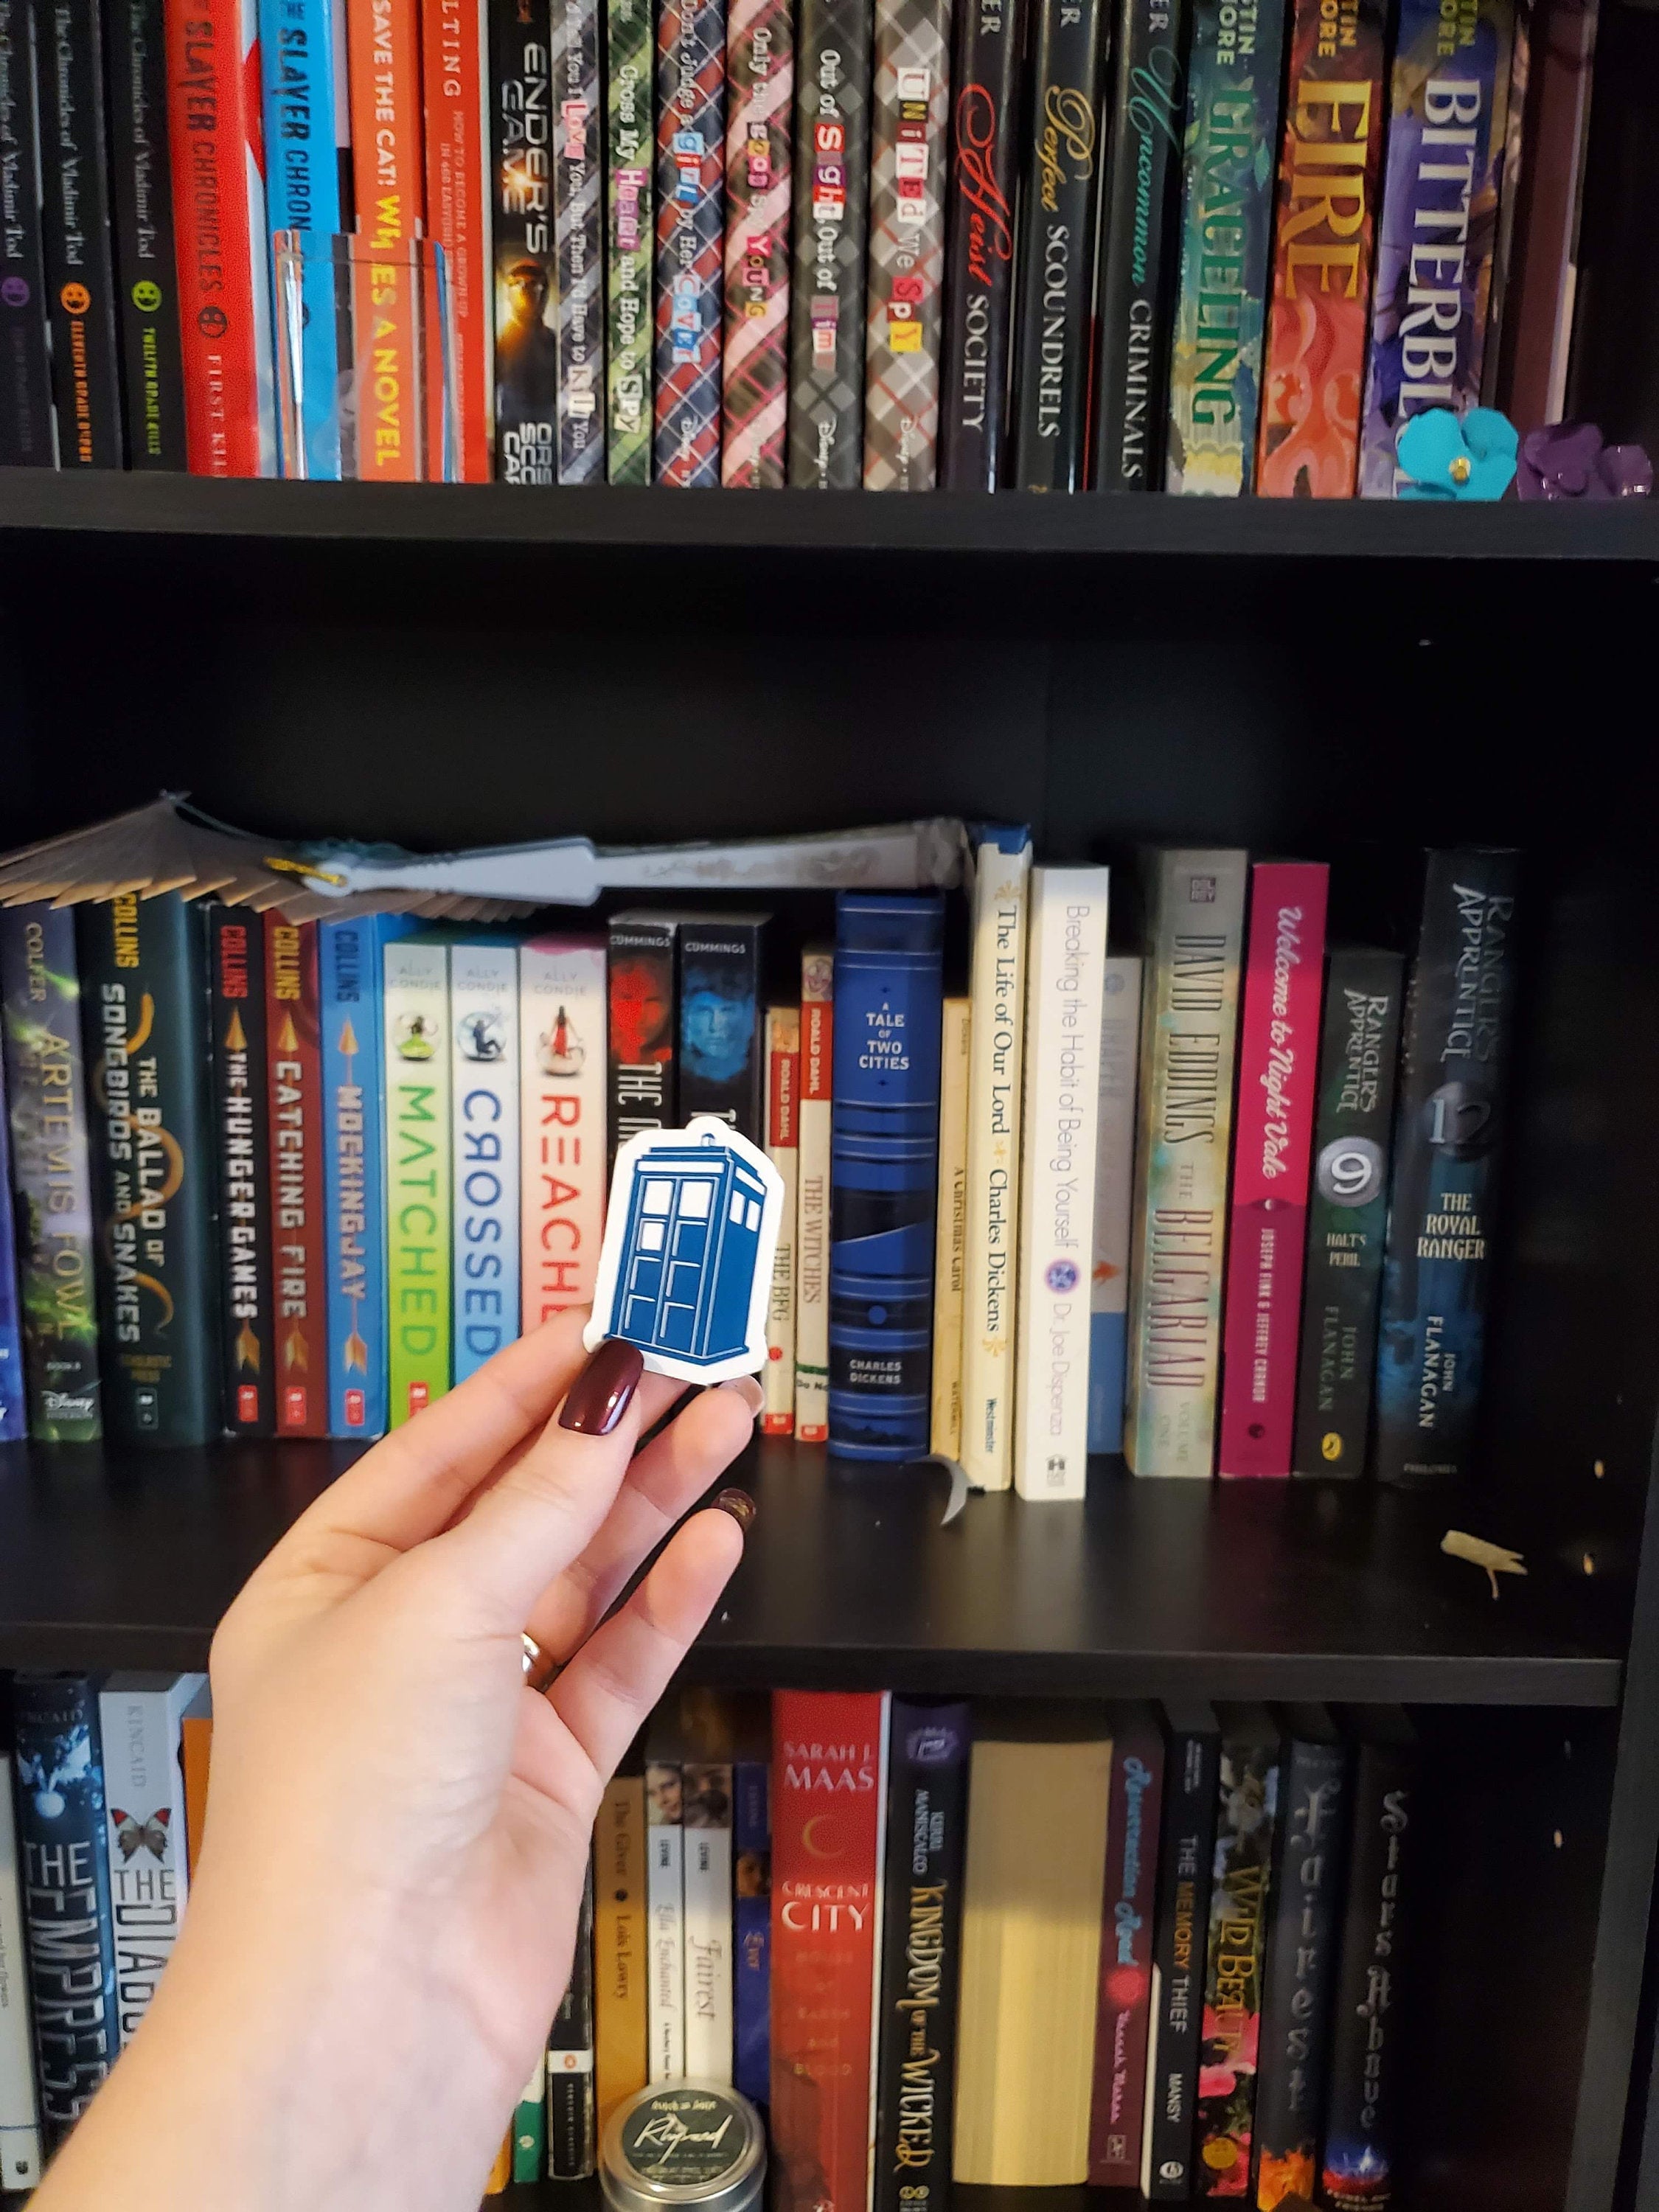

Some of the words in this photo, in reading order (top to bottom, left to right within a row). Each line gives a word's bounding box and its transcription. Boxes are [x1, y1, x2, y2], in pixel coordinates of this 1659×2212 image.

[372, 0, 393, 65] SAVE
[748, 27, 772, 75] Only
[178, 21, 217, 131] SLAYER
[271, 28, 310, 140] SLAYER
[567, 51, 584, 85] You
[678, 52, 698, 110] Judge
[820, 49, 841, 89] Out
[375, 71, 395, 122] THE
[819, 93, 841, 119] of
[375, 128, 397, 186] CAT!
[502, 80, 524, 215] GAME
[524, 43, 548, 254] ENDER'S
[616, 129, 640, 160] My
[1034, 85, 1096, 213] Perfect
[1128, 46, 1183, 287] Uncommon
[62, 156, 83, 228] Vladimir
[136, 150, 156, 221] Vladimir
[954, 83, 1012, 288] Heist
[1281, 79, 1371, 300] FIRE
[5, 224, 27, 258] Tod
[137, 224, 158, 259] Tod
[193, 142, 223, 292] CHRONICLES
[66, 232, 86, 265] Tod
[571, 234, 587, 274] Then
[678, 235, 698, 267] Her
[817, 226, 838, 263] Out
[1192, 86, 1253, 425] GRACELING
[620, 255, 639, 291] and
[816, 266, 837, 291] of
[374, 316, 397, 339] A
[571, 304, 588, 342] Have
[616, 298, 640, 345] Hope
[1037, 225, 1070, 438] SCOUNDRELS
[571, 346, 587, 363] to
[621, 351, 636, 369] to
[963, 294, 990, 434] SOCIETY
[207, 355, 226, 423] FIRST
[374, 348, 400, 467] NOVEL
[1121, 299, 1152, 479] CRIMINALS
[572, 422, 588, 451] You
[113, 898, 139, 969] COLLINS
[610, 934, 671, 947] CUMMINGS
[684, 942, 746, 954] CUMMINGS
[998, 905, 1018, 950] The
[1057, 905, 1090, 991] Breaking
[221, 925, 248, 998] COLLINS
[274, 926, 300, 1001] COLLINS
[335, 931, 360, 1003] COLLINS
[995, 958, 1015, 998] Life
[1171, 934, 1226, 1012] DAVID
[1271, 905, 1304, 1017] Welcome
[1439, 883, 1486, 1063] APPRENTICE
[810, 1008, 821, 1053] ROALD
[866, 1012, 905, 1027] TALE
[882, 1002, 889, 1011] A
[994, 1004, 1015, 1026] of
[1062, 998, 1088, 1028] the
[866, 1040, 902, 1054] TWO
[878, 1029, 891, 1038] OF
[992, 1032, 1013, 1076] Our
[1270, 1019, 1293, 1046] to
[1336, 988, 1368, 1115] APPRENTICE
[1359, 995, 1389, 1115] RANGER'S
[102, 984, 131, 1161] SONGBIRDS
[138, 1057, 157, 1097] THE
[227, 1052, 248, 1088] THE
[618, 1062, 662, 1106] THE
[780, 1059, 792, 1103] ROALD
[808, 1054, 821, 1096] DAHL
[859, 1054, 910, 1070] CITIES
[1060, 1034, 1085, 1088] Habit
[1259, 1047, 1295, 1119] Night
[991, 1084, 1012, 1135] Lord
[1058, 1093, 1084, 1113] of
[1164, 1032, 1221, 1144] EDDINGS
[40, 1032, 77, 1215] ARTEMIS
[274, 1060, 305, 1229] CATCHING
[779, 1105, 790, 1140] DAHL
[1049, 1119, 1082, 1172] Being
[137, 1106, 167, 1229] BALLAD
[224, 1096, 257, 1219] HUNGER
[1262, 1121, 1290, 1180] Vale
[115, 1169, 131, 1214] AND
[336, 1085, 366, 1299] MOCKINGJAY
[804, 1175, 824, 1216] THE
[987, 1169, 1008, 1245] Charles
[1179, 1165, 1195, 1200] THE
[1441, 1193, 1472, 1211] THE
[399, 1085, 438, 1357] MATCHED
[1054, 1177, 1079, 1249] Yourself
[1425, 1214, 1480, 1236] ROYAL
[145, 1239, 165, 1267] OF
[229, 1225, 259, 1319] GAMES
[773, 1243, 792, 1284] THE
[802, 1218, 823, 1304] WITCHES
[1416, 1237, 1486, 1259] RANGER
[49, 1233, 85, 1339] FOWL
[113, 1222, 140, 1343] SNAKES
[279, 1245, 307, 1319] FIRE
[771, 1286, 790, 1324] BFG
[986, 1251, 1006, 1332] Dickens
[1147, 1208, 1214, 1388] BELGARIAD
[1053, 1303, 1073, 1324] Dr.
[849, 1359, 902, 1372] CHARLES
[1049, 1328, 1071, 1356] Joe
[1318, 1306, 1340, 1411] FLANAGAN
[1338, 1326, 1357, 1381] JOHN
[849, 1371, 901, 1385] DICKENS
[1419, 1315, 1444, 1428] FLANAGAN
[1441, 1354, 1457, 1392] JOHN
[1046, 1361, 1071, 1437] Dispenza
[127, 1705, 147, 1788] KINCAID
[784, 1742, 855, 1761] SARAH
[784, 1764, 874, 1792] MAAS
[1178, 1834, 1199, 1875] THE
[114, 1869, 176, 1901] THE
[616, 1914, 633, 1948] Lois
[782, 1902, 871, 1933] CITY
[1174, 1881, 1192, 1969] MEMORY
[895, 1879, 948, 2011] KINGDOM
[613, 1950, 633, 2001] Lowry
[689, 1934, 723, 2022] Fairest
[1169, 1974, 1189, 2035] THIEF
[894, 2050, 941, 2173] WICKED
[1166, 2072, 1183, 2124] MANSY
